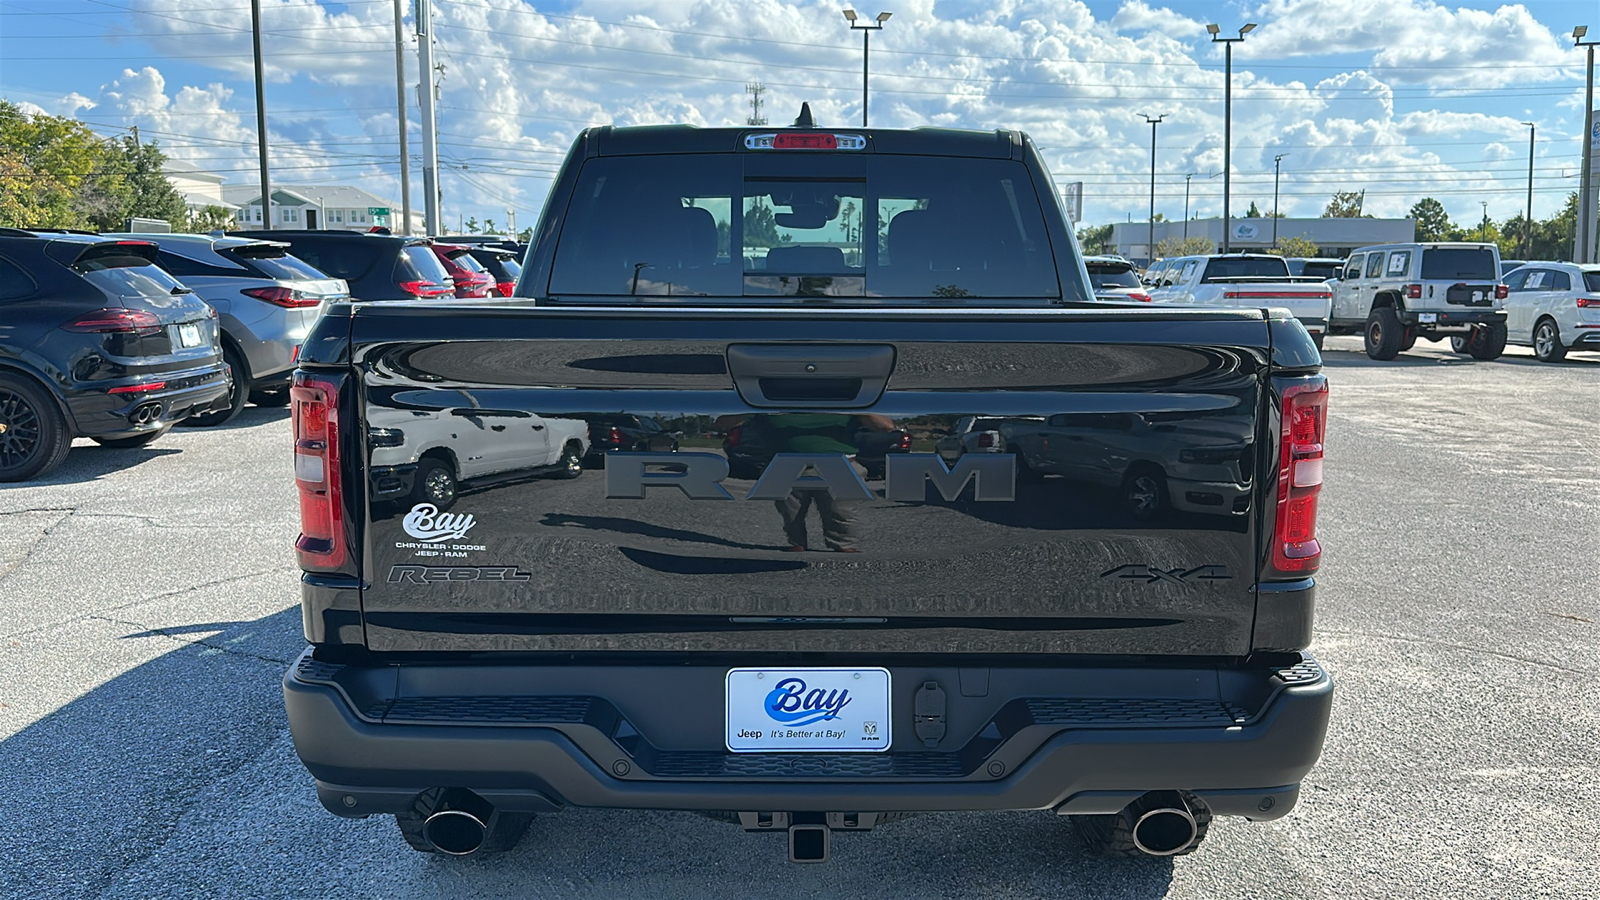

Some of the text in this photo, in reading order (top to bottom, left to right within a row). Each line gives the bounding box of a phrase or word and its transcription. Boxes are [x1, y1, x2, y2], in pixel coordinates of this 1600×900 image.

[604, 451, 1017, 502] RAM
[402, 503, 477, 541] Bay
[768, 677, 852, 722] Bay
[737, 729, 762, 739] Jeep
[770, 730, 846, 740] It's Better at Bay!
